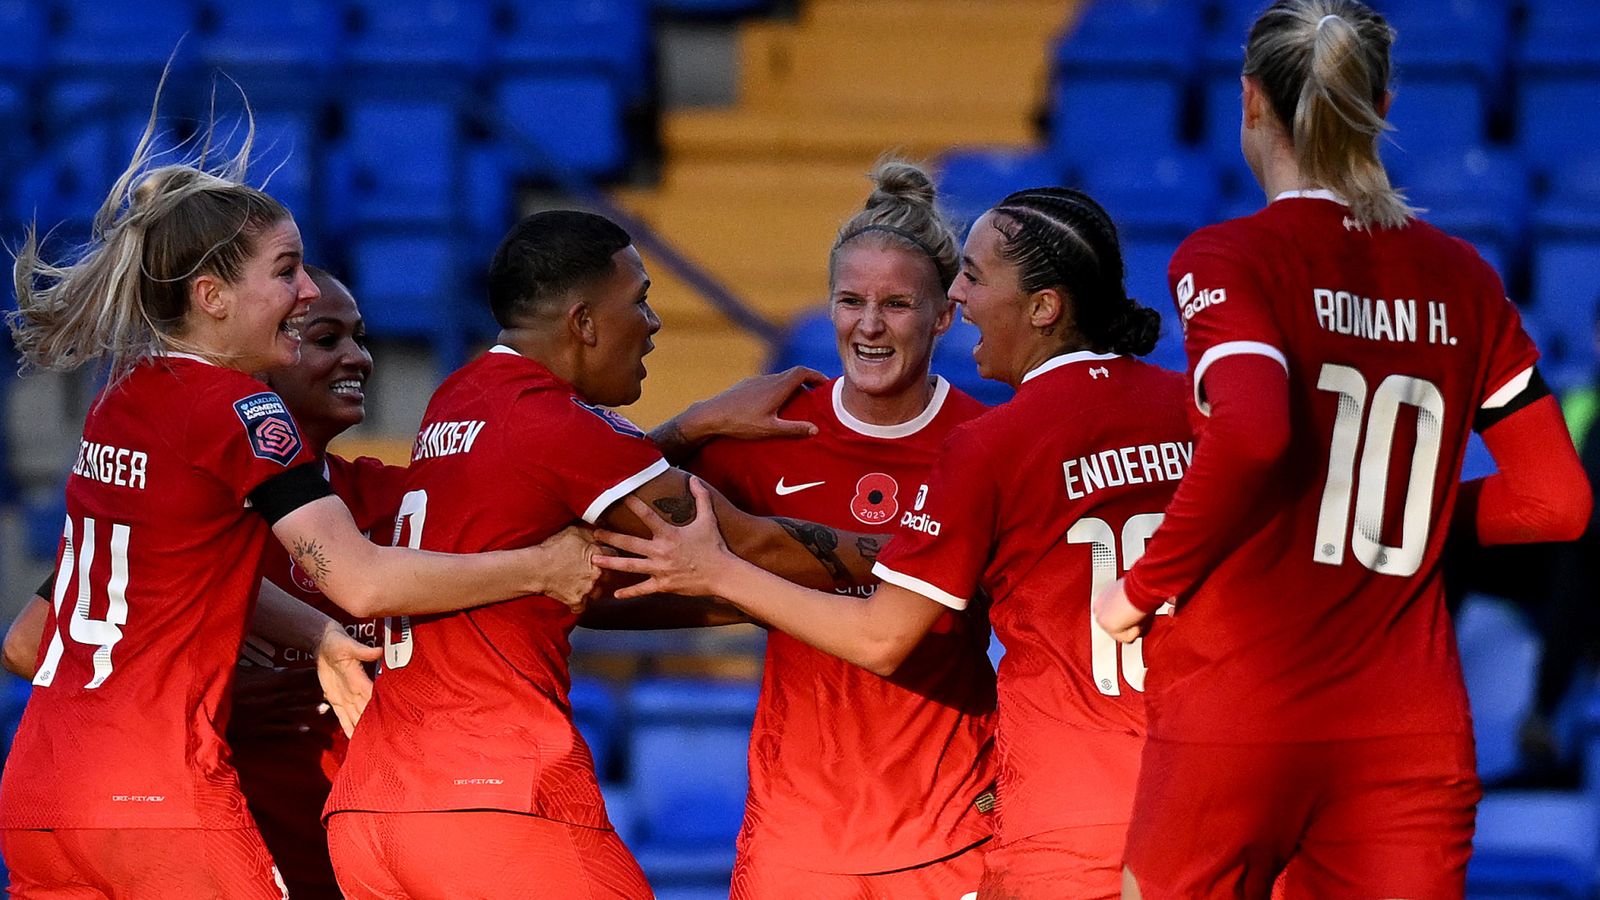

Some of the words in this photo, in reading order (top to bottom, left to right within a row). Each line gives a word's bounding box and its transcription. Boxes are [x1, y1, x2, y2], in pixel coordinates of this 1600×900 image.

[1183, 287, 1226, 323] edia
[1313, 288, 1417, 342] ROMAN
[1428, 301, 1458, 346] H.
[1313, 362, 1444, 578] 10
[860, 508, 886, 520] 2023
[301, 577, 315, 588] 20
[31, 513, 132, 690] 14
[344, 618, 377, 639] ard
